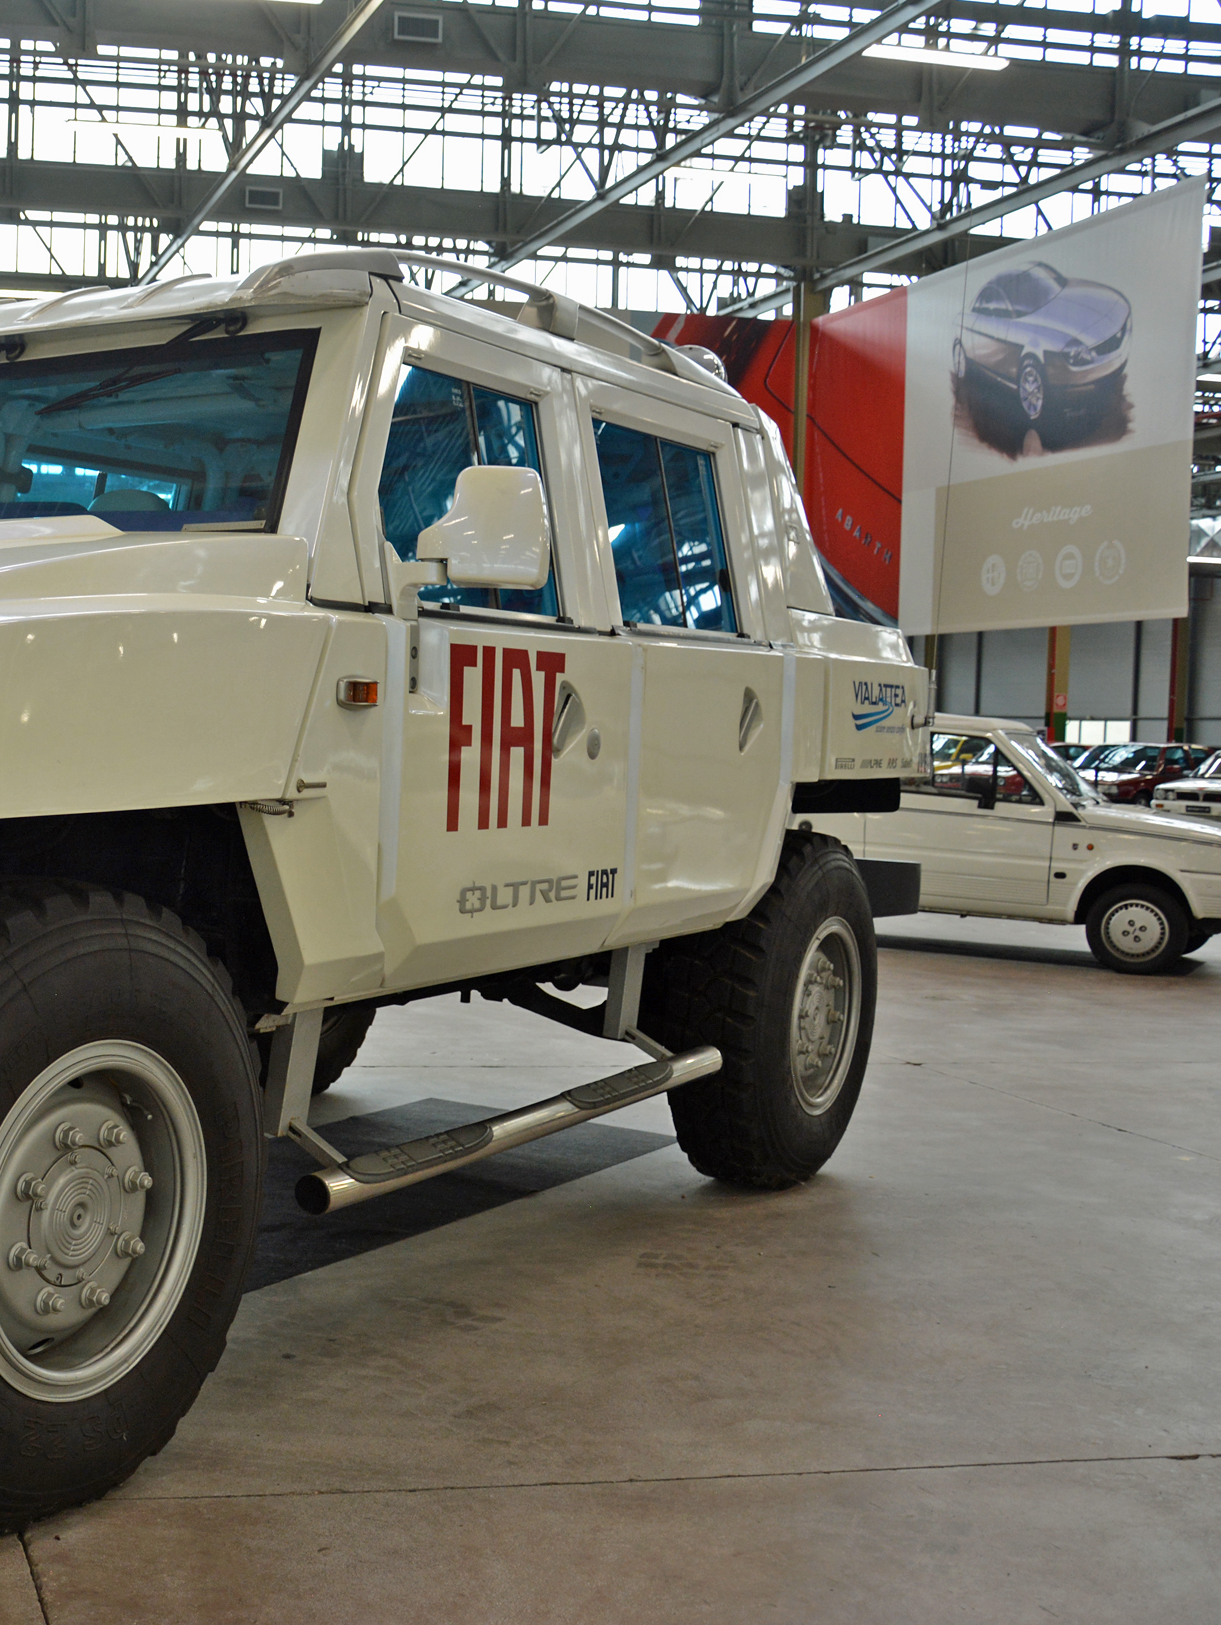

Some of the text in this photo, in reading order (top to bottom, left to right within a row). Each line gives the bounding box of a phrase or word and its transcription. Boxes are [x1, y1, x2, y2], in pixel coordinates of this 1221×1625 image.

[835, 508, 893, 564] ABARTH
[1012, 504, 1093, 530] Heritage
[852, 680, 906, 708] VIALATTEA
[446, 643, 566, 832] FIAT
[457, 867, 618, 917] OLTRE FIAT
